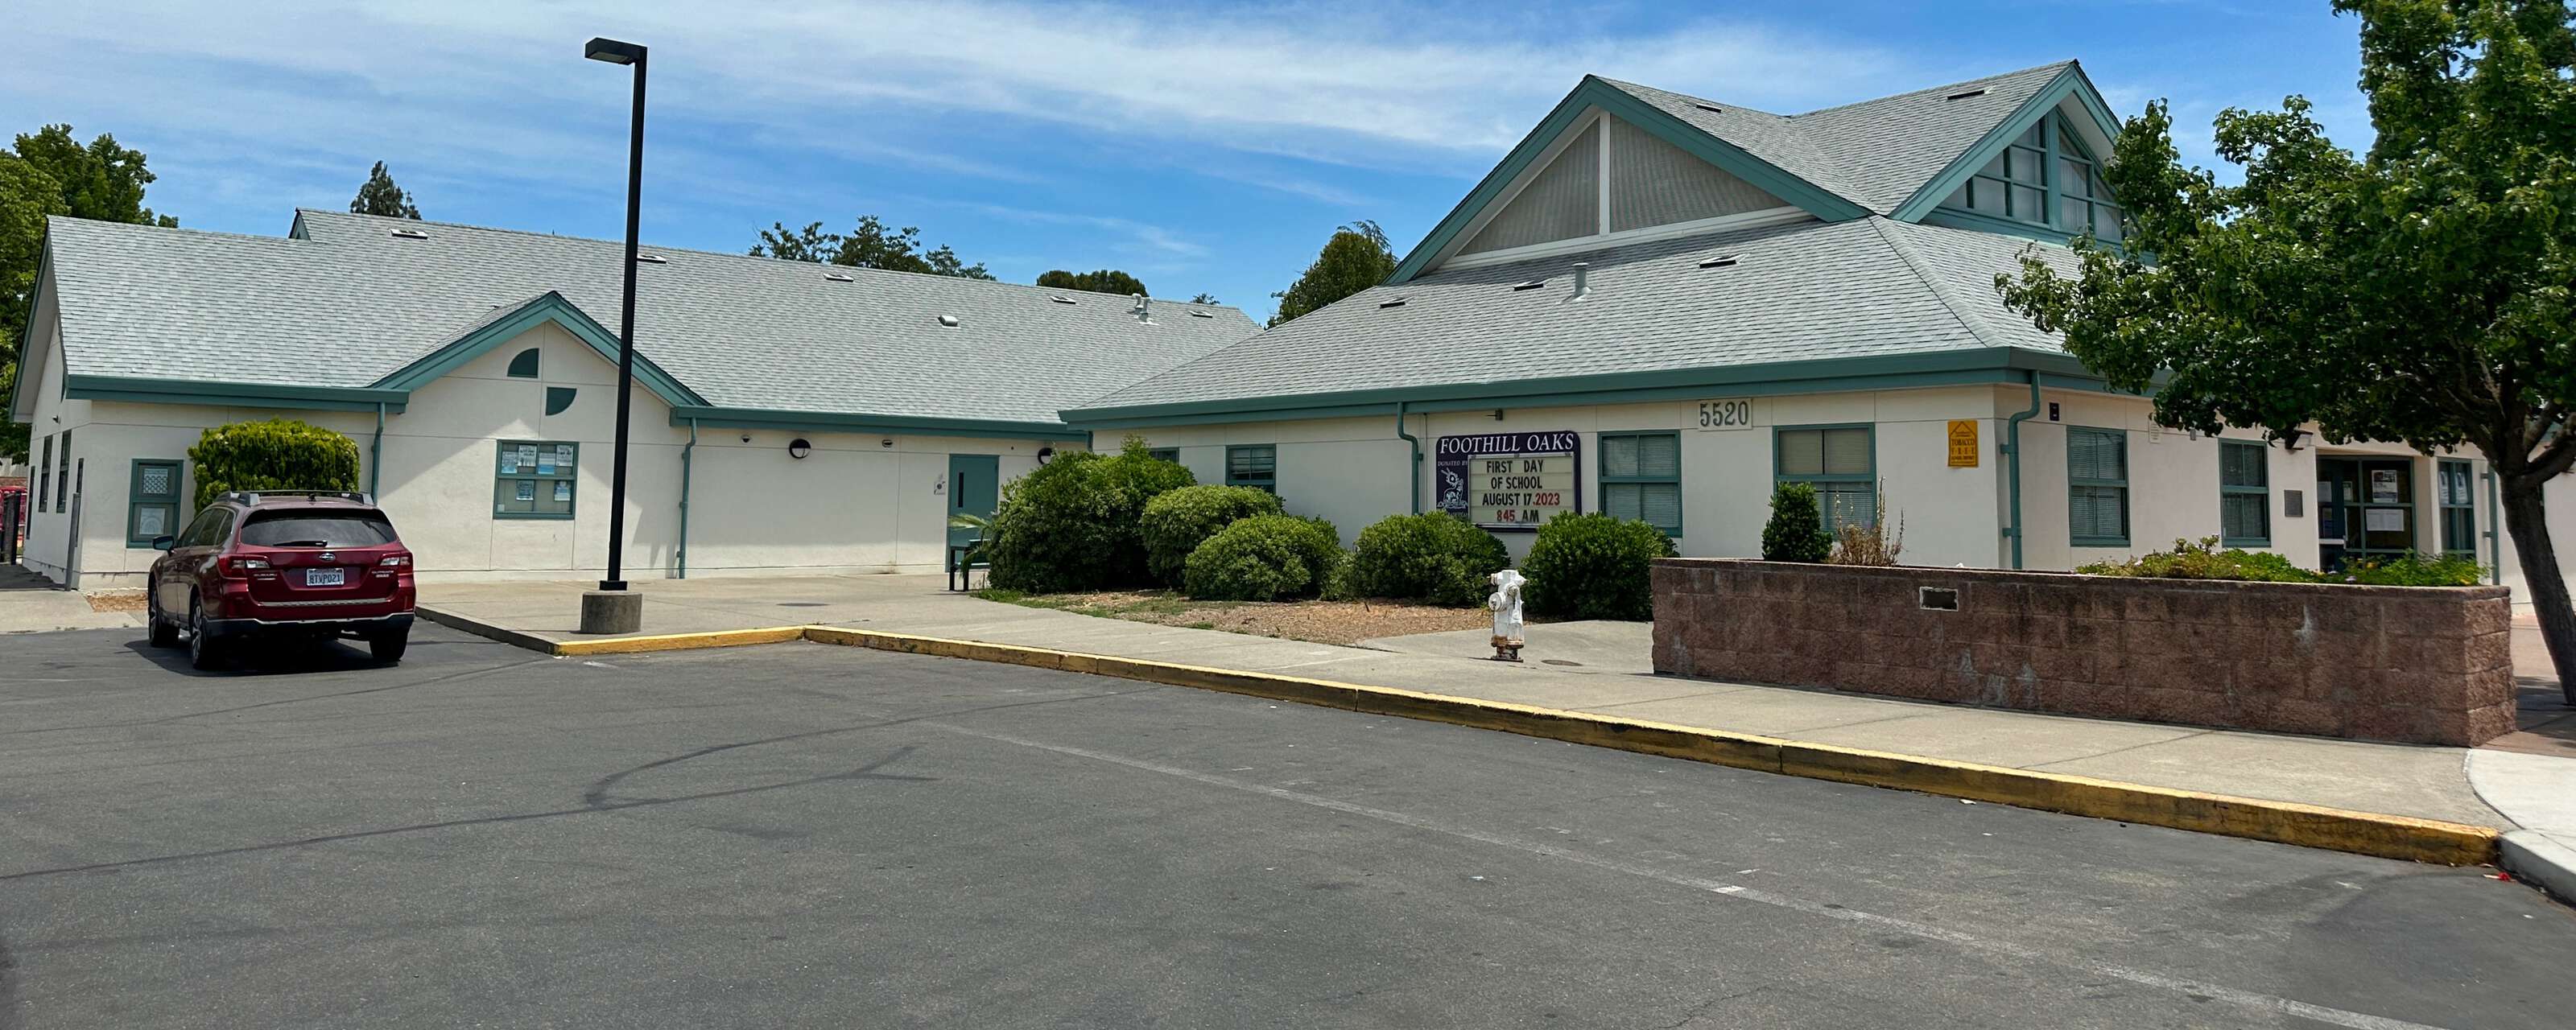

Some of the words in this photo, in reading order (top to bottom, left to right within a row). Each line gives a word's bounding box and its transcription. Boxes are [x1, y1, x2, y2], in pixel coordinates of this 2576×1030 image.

[1699, 401, 1748, 426] 5520
[1439, 435, 1520, 454] FOOTHILL
[1527, 433, 1574, 451] OAKS
[1486, 460, 1513, 473] FIRST
[1524, 459, 1543, 472] DAY
[1491, 477, 1503, 489] OF
[1506, 476, 1542, 489] SCHOOL
[1482, 492, 1520, 505] AUGUST
[1496, 509, 1515, 522] 845
[1522, 509, 1539, 522] AM
